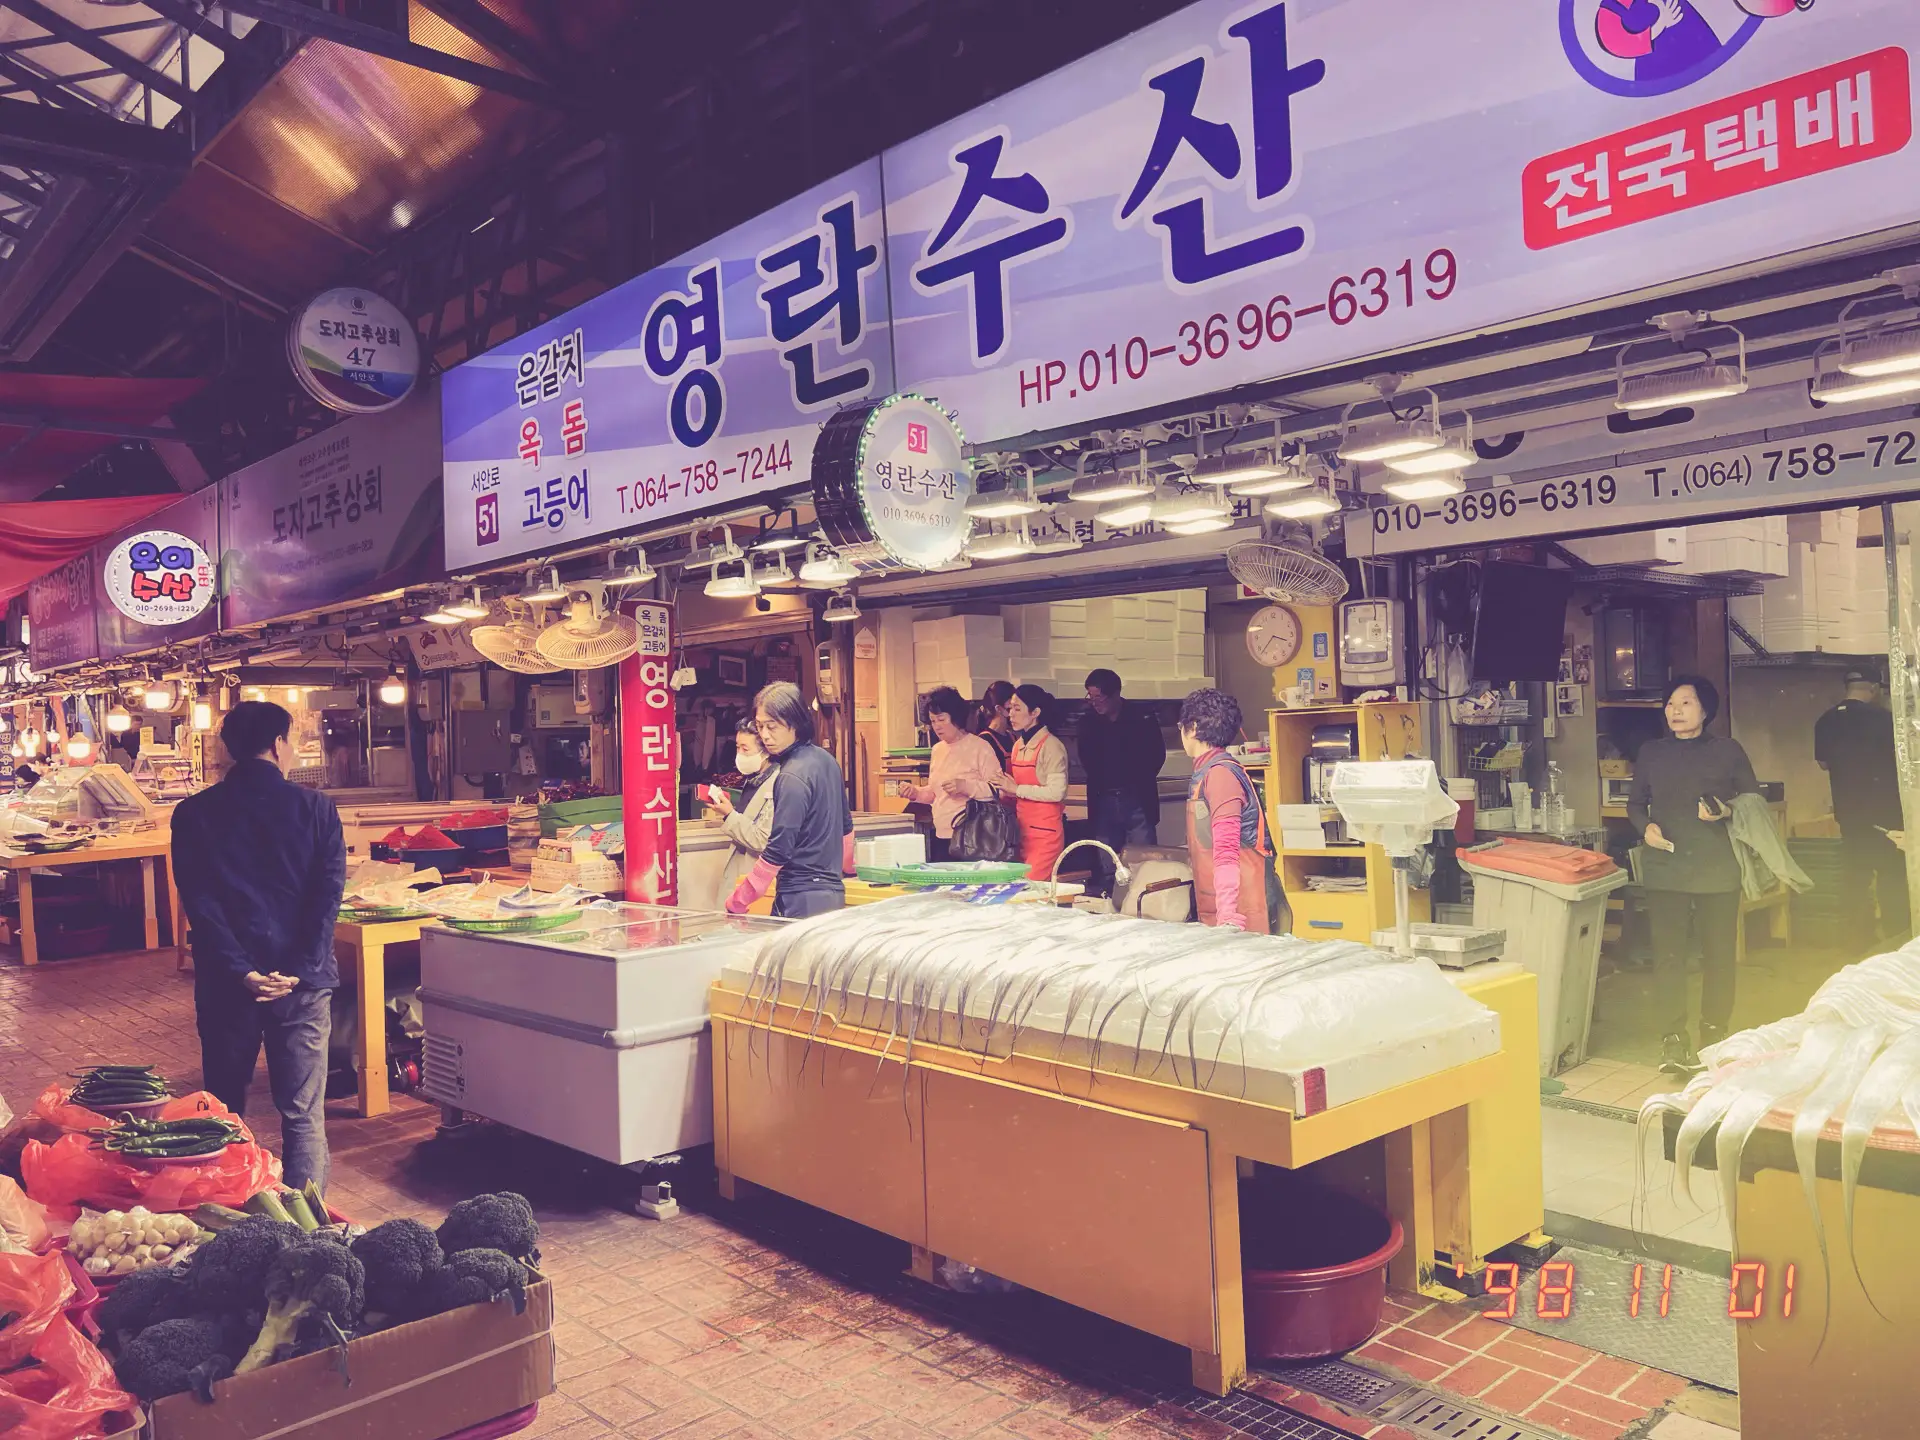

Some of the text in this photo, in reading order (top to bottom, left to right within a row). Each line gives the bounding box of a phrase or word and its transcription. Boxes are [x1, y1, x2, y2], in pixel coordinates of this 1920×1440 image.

[1543, 71, 1875, 230] 전국택배
[643, 2, 1326, 447] 영란수산
[346, 347, 376, 367] 47
[1018, 249, 1457, 408] HP.010-3696-6319
[516, 329, 584, 404] 은갈치
[909, 428, 927, 450] 51
[271, 465, 382, 545] 도자고추상회
[471, 467, 501, 491] 서안로
[522, 468, 590, 531] 고등어
[616, 440, 793, 514] T.064-758-7244
[875, 461, 957, 500] 영란수산
[1373, 474, 1617, 535] 010-3696-6319
[478, 500, 500, 537] 51
[883, 506, 950, 528] 010.3696.6319
[131, 571, 196, 602] 수산
[642, 640, 666, 653] 고등어
[640, 661, 673, 905] 영란수산
